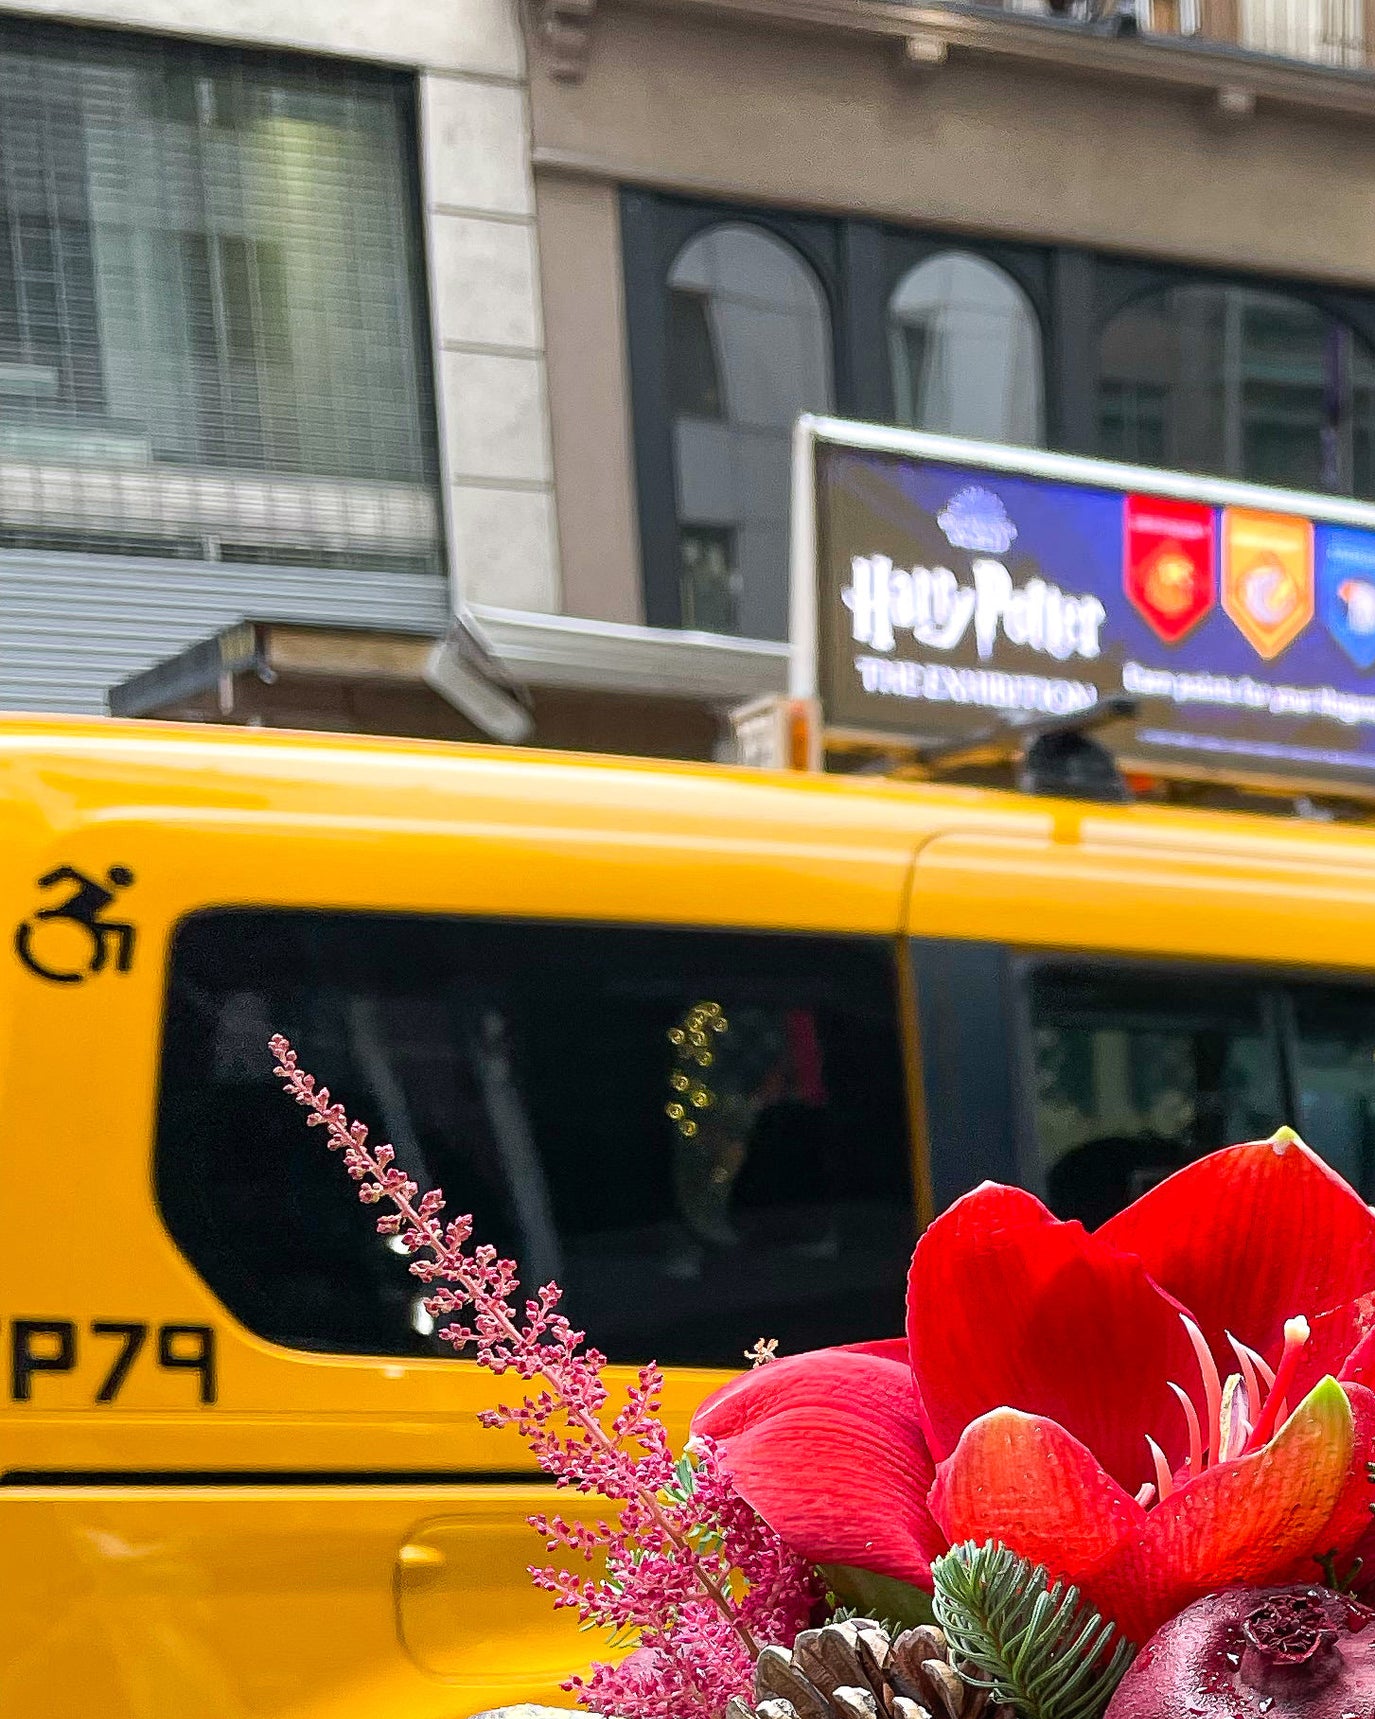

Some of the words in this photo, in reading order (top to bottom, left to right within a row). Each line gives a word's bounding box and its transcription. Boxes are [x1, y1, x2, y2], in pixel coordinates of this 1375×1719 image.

[841, 553, 976, 652] Harry
[972, 558, 1107, 661] Potter
[854, 655, 924, 699] THE
[922, 663, 1099, 716] EXHIBITION
[0, 1317, 217, 1404] P79
